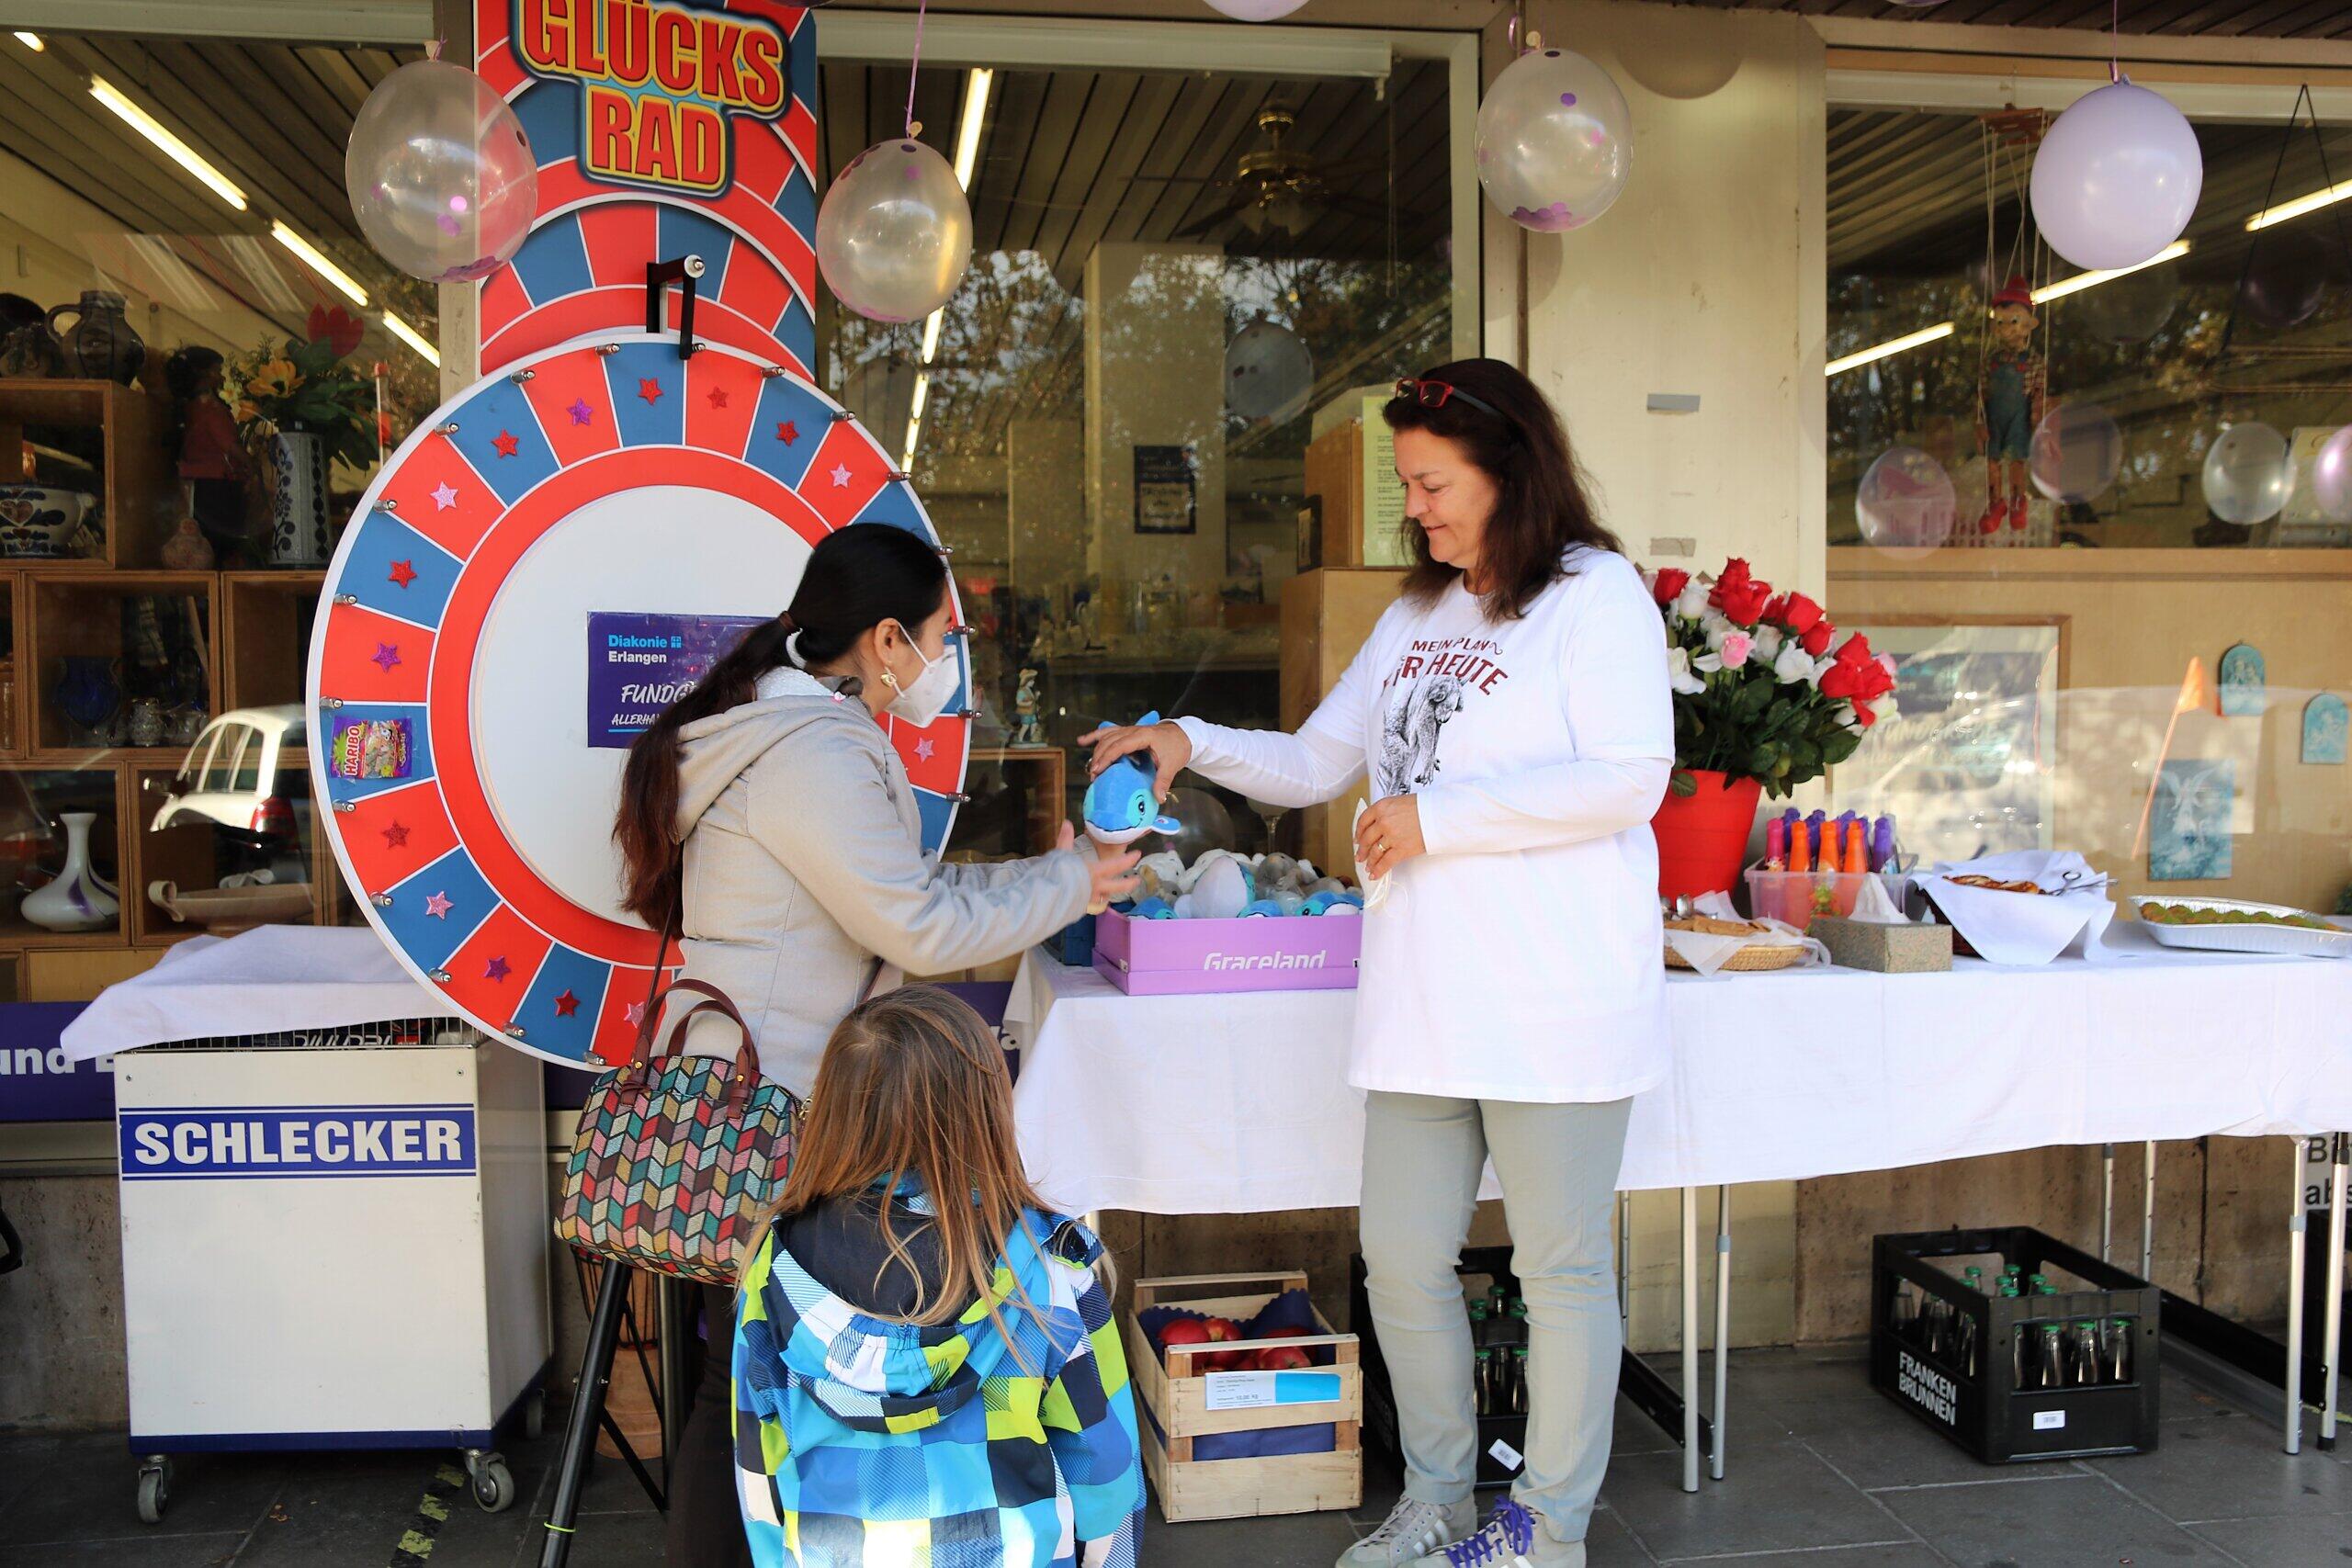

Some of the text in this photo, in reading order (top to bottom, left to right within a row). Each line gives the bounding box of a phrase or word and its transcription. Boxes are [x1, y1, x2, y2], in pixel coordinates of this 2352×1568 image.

[523, 0, 781, 107] GLÜCKS
[591, 90, 721, 185] RAD
[608, 635, 668, 649] Diakonie
[608, 650, 667, 665] Erlangen
[1411, 637, 1491, 652] MEIN PLAN
[621, 682, 695, 704] FUNDG
[1425, 652, 1509, 696] HEUTE
[611, 713, 661, 726] ALLERHA
[344, 726, 361, 776] HARIBO
[1204, 950, 1327, 971] Graceland
[134, 1119, 462, 1166] SCHLECKER
[1898, 1371, 1956, 1426] BRUNNEN
[1899, 1350, 1957, 1404] FRANKEN
